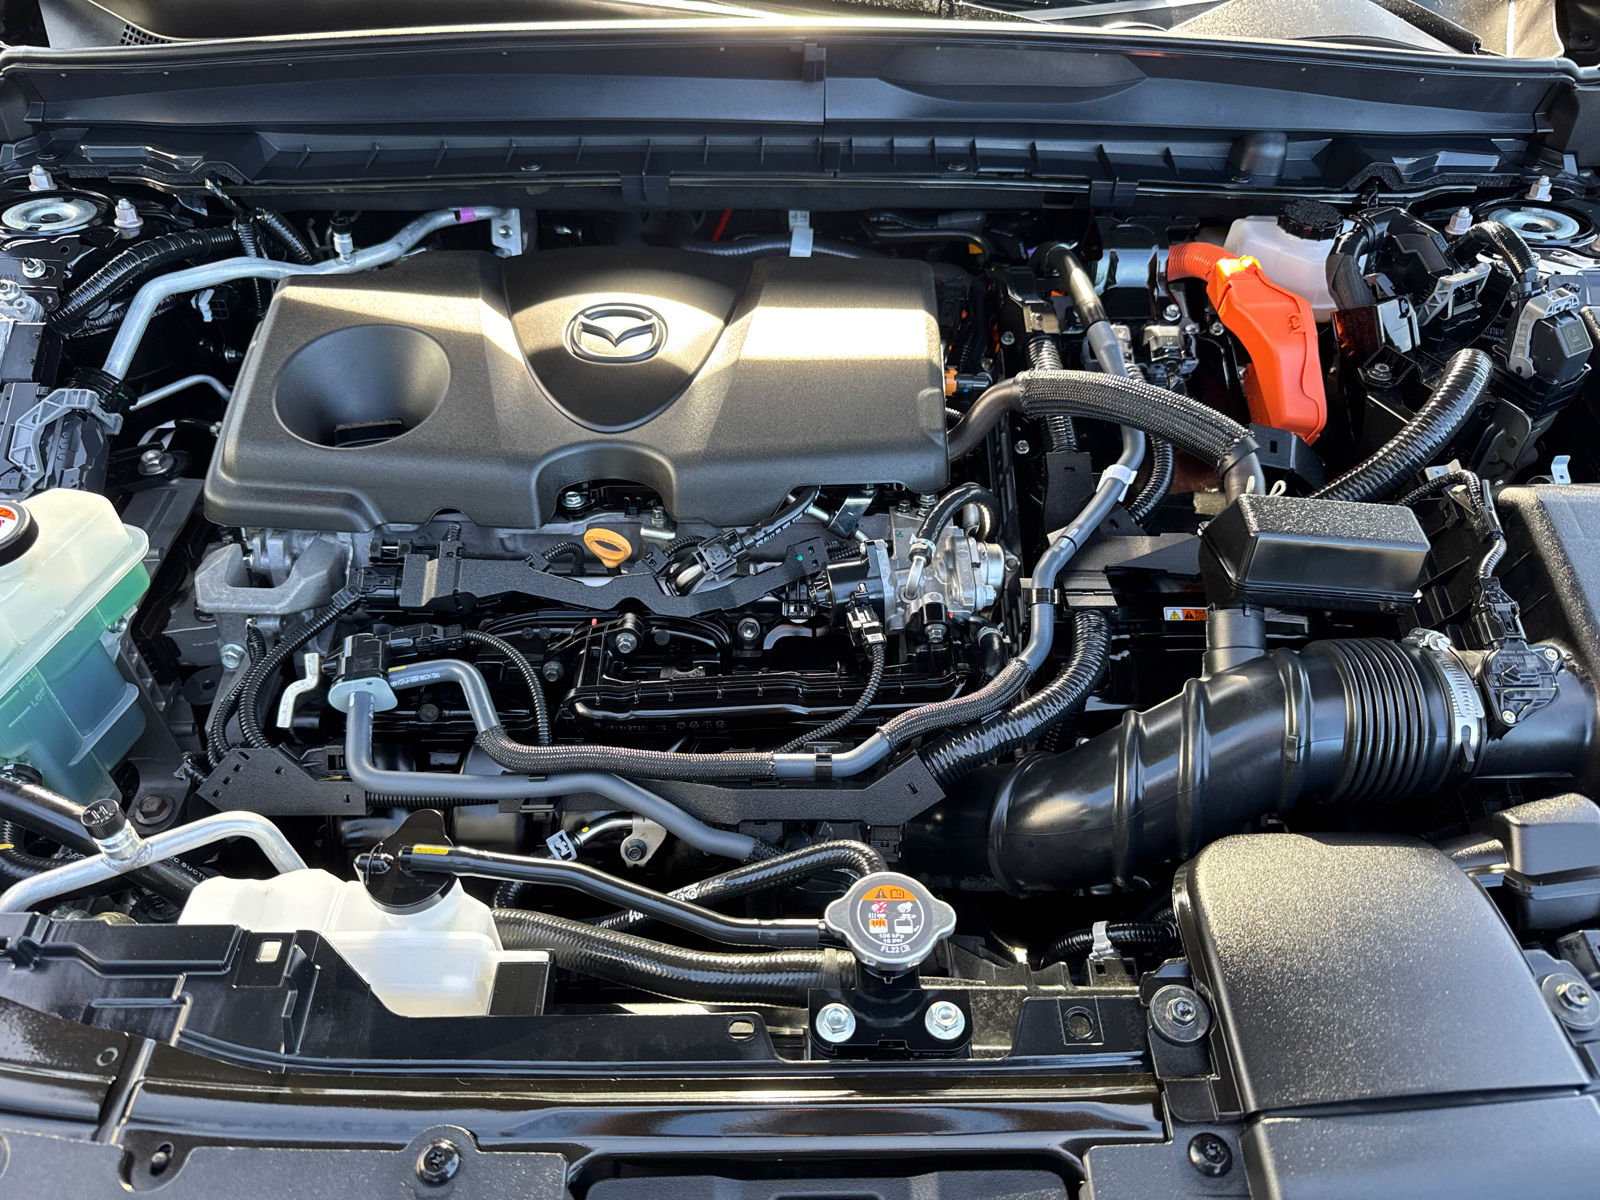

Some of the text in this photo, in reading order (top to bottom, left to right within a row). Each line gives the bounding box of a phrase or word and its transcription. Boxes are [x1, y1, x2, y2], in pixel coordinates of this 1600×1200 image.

[31, 687, 46, 707] LOW
[181, 862, 208, 880] SUCTI
[880, 945, 901, 953] FL22
